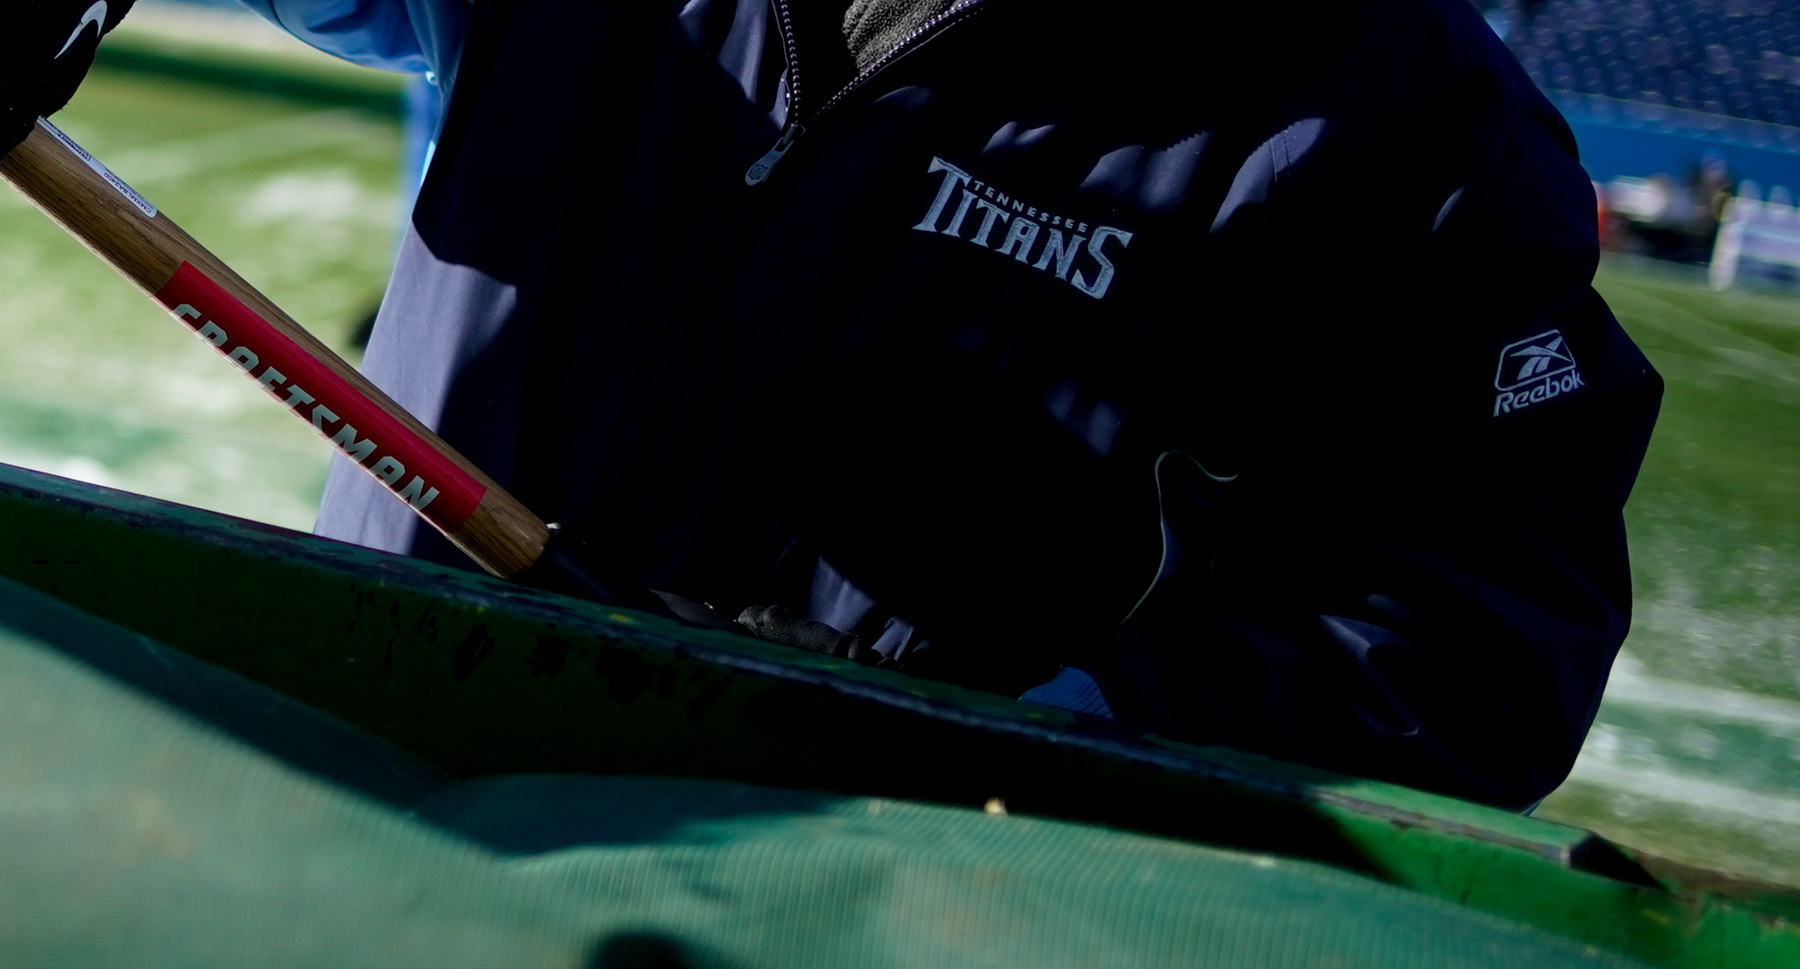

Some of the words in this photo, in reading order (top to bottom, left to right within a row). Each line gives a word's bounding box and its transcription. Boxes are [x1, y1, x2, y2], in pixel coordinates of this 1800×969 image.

[911, 155, 1134, 300] TITANS
[973, 179, 1089, 233] TENNESSEE
[1493, 369, 1585, 418] Reebok
